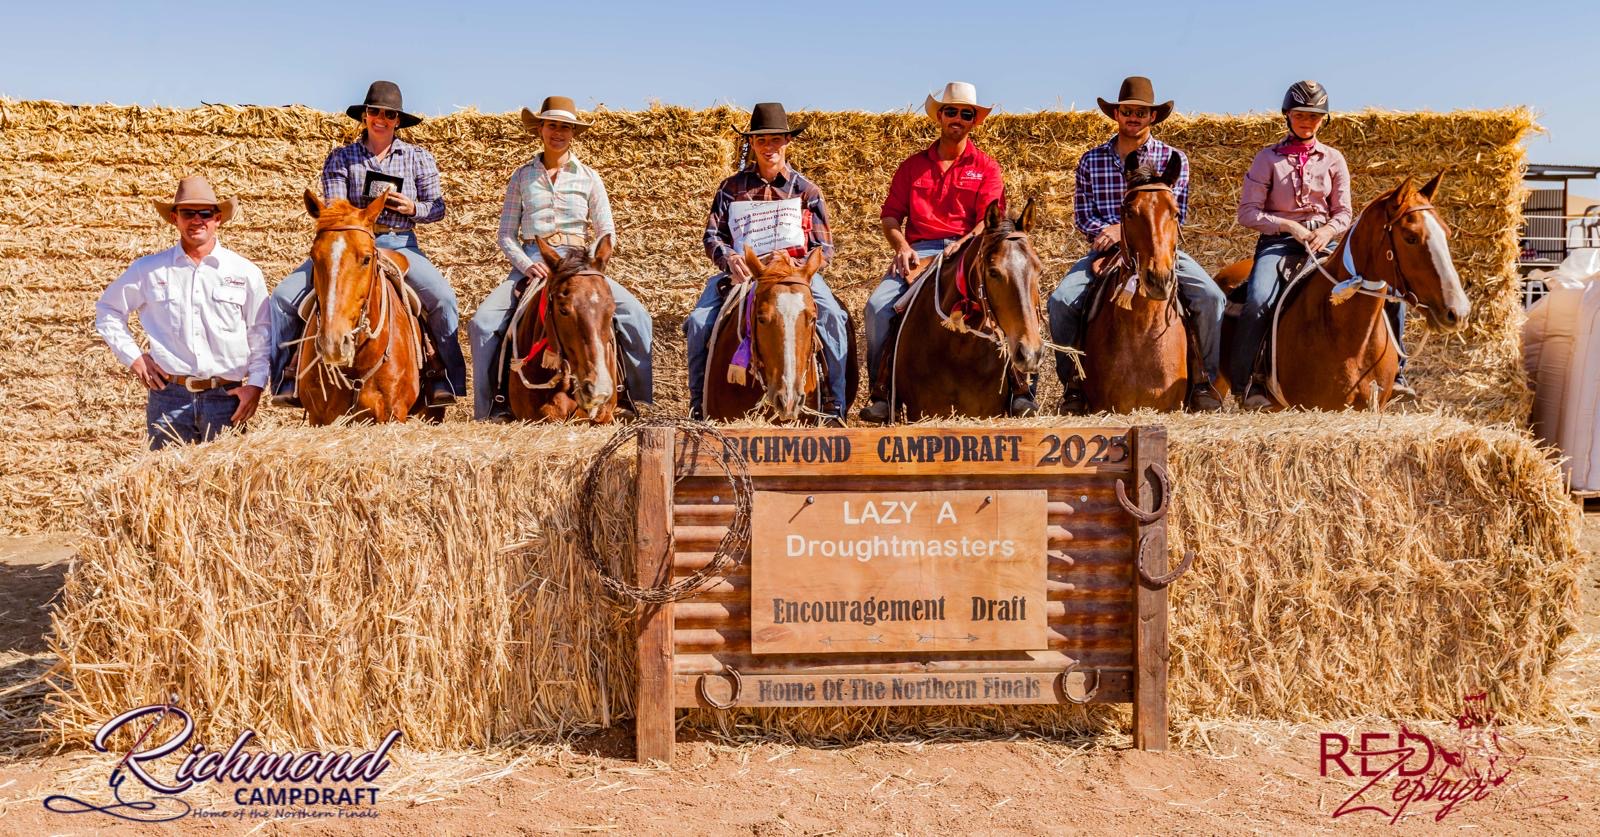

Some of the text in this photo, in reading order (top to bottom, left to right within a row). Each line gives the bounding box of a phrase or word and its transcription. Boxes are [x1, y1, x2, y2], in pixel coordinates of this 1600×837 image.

[722, 434, 1129, 465] RICHMOND CAMPDRAFT 2025
[844, 500, 957, 525] LAZY A
[786, 534, 1015, 562] Droughtmasters
[773, 596, 1026, 626] Encouragement Draft
[758, 676, 1041, 702] Home Of The Northern Finals
